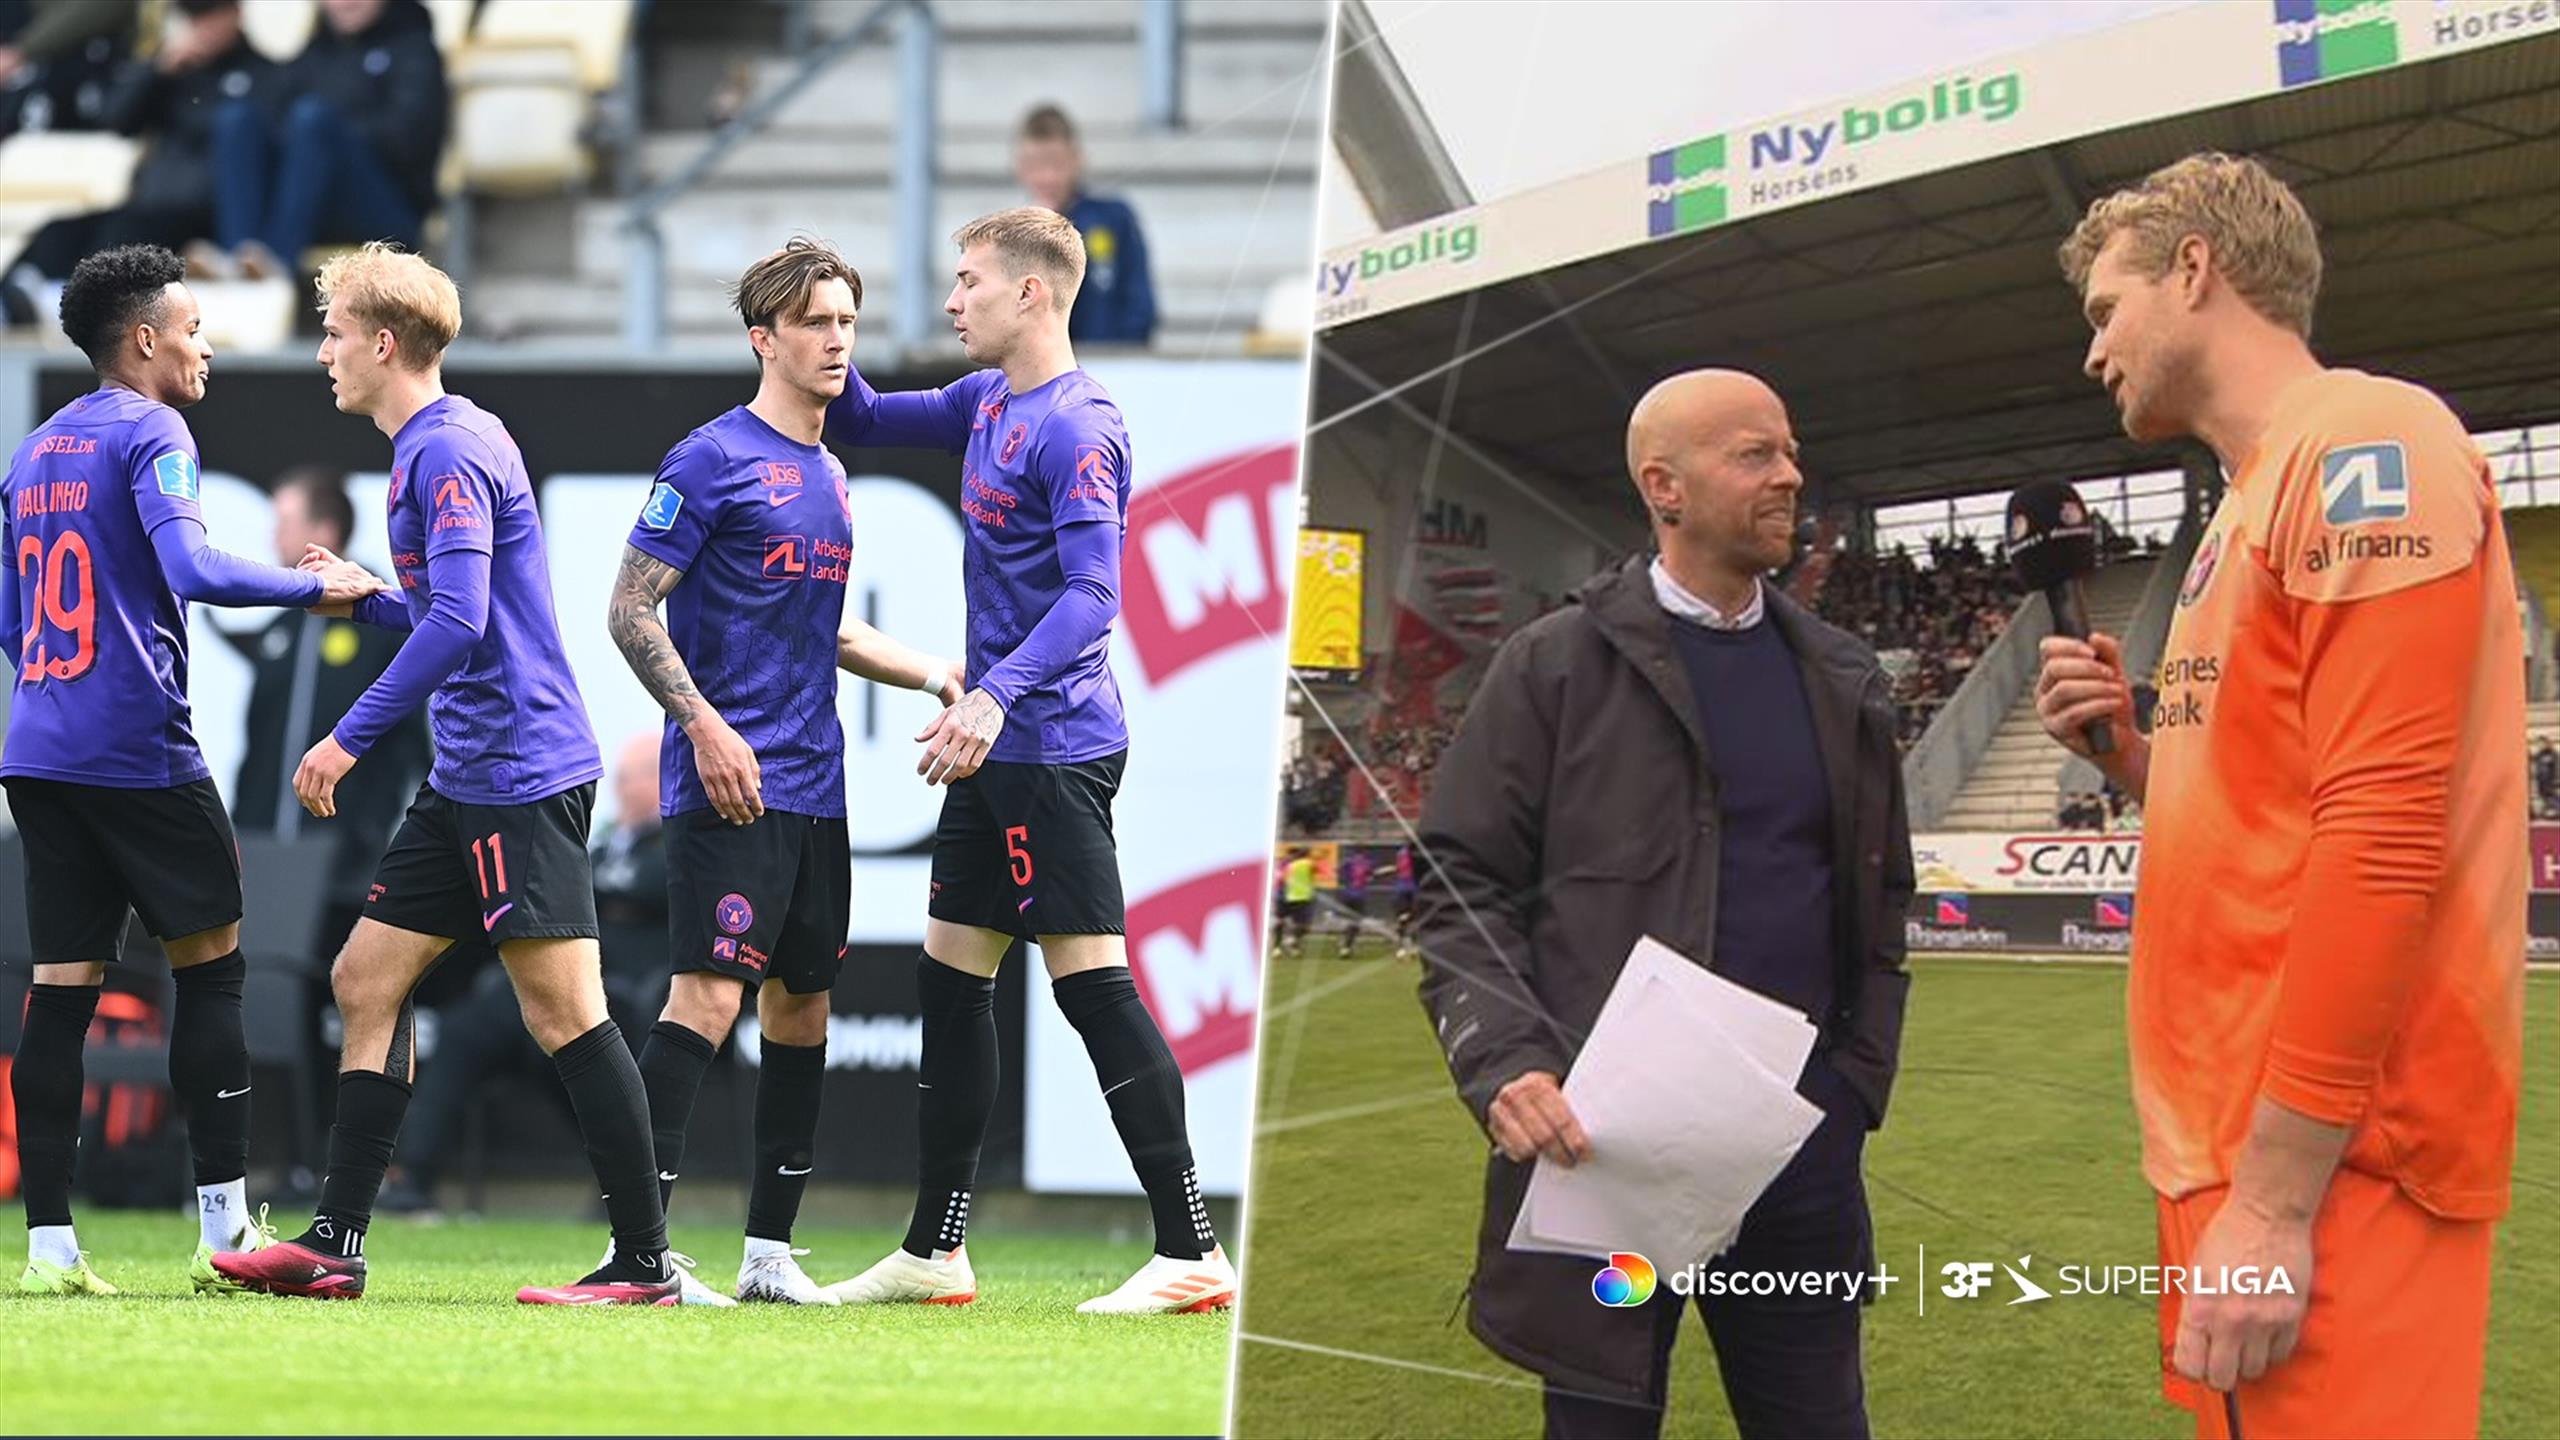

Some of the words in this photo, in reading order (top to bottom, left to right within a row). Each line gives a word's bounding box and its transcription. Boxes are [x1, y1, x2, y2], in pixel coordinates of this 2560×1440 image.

[1749, 73, 2021, 170] Nybolig
[1749, 164, 1860, 204] Horsens
[2306, 534, 2332, 573] al
[2338, 530, 2433, 561] finans
[18, 529, 96, 682] 29
[471, 831, 508, 899] 11
[1006, 825, 1033, 887] 5
[1996, 836, 2139, 876] SCAN
